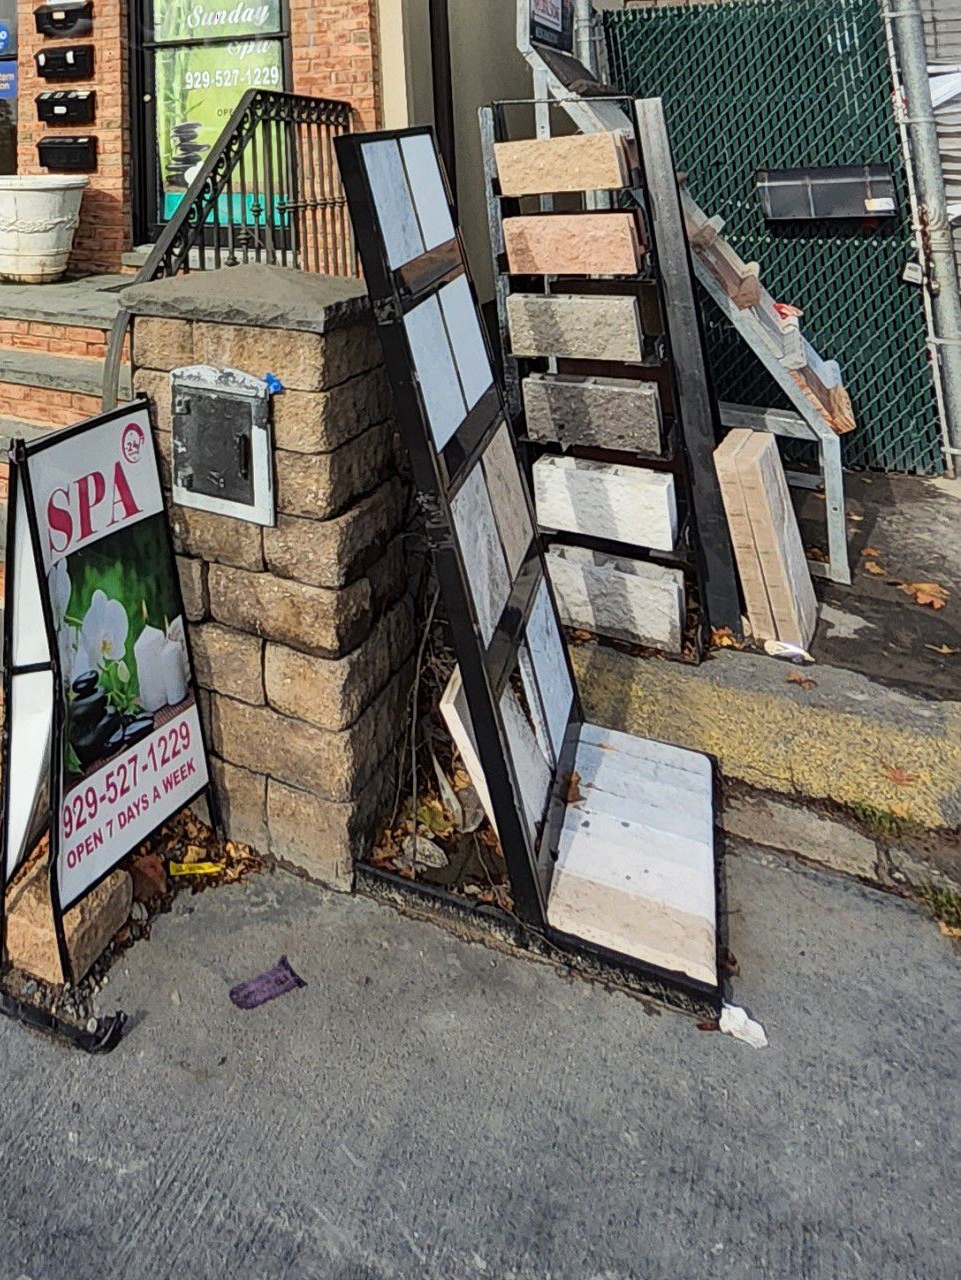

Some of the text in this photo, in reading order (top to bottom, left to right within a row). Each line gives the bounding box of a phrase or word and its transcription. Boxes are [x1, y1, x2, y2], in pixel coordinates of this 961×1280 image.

[187, 2, 270, 29] Sunday
[185, 66, 280, 90] 929-527-1229
[216, 107, 236, 118] OPE
[47, 461, 143, 558] SPA
[62, 720, 191, 839] 929-527-1229
[66, 757, 197, 869] OPEN 7 DAYS A WEEK
